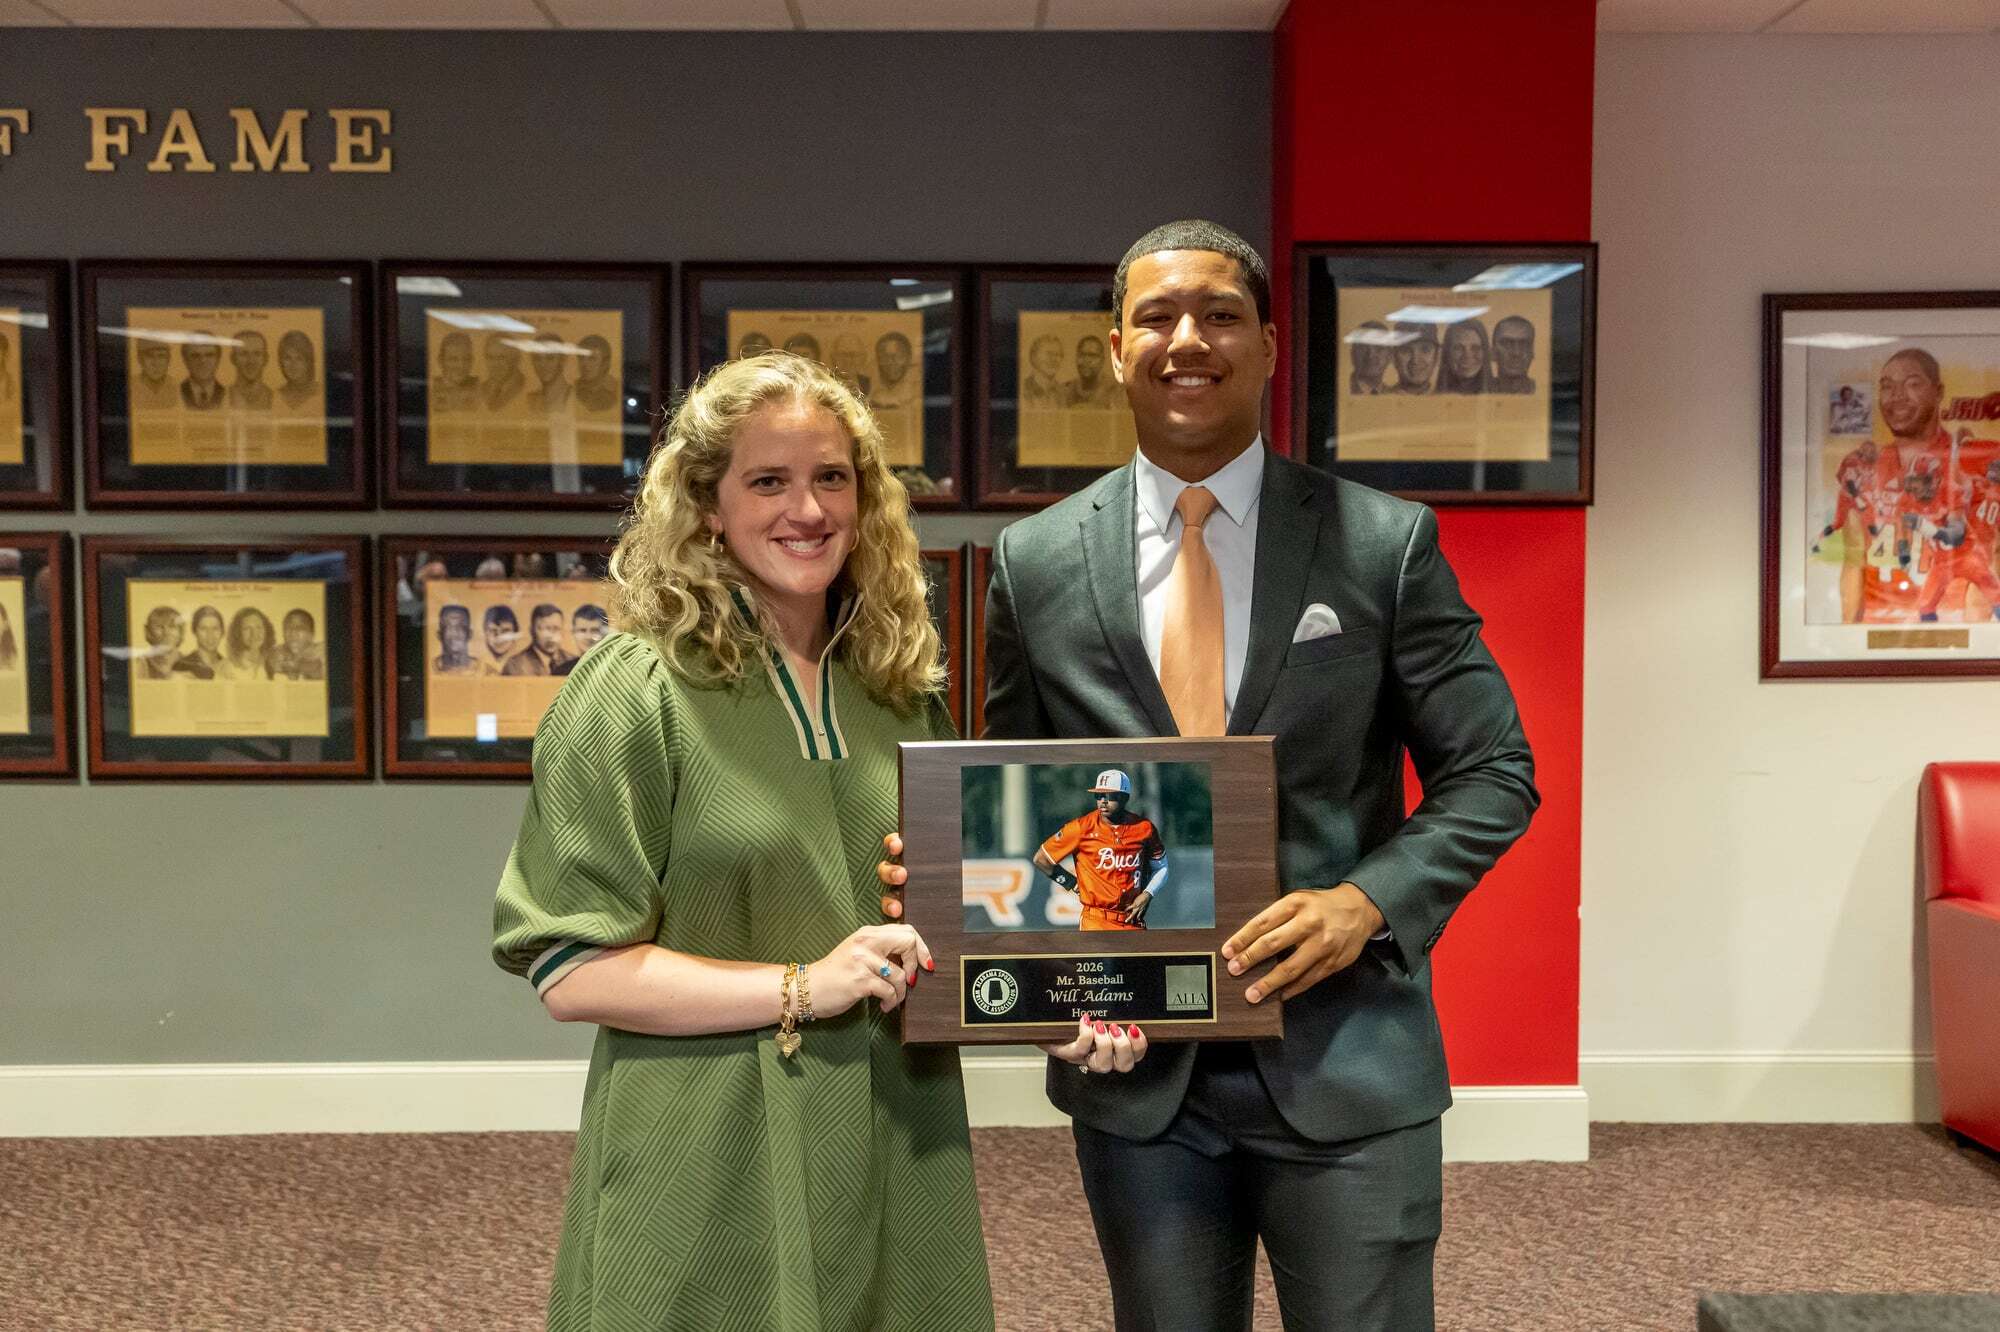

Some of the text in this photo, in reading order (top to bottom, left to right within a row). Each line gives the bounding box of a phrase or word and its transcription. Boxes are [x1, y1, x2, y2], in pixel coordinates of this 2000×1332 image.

[84, 108, 392, 173] FAME
[1096, 847, 1142, 869] Bucs
[1076, 962, 1104, 973] 2026
[1056, 974, 1124, 986] Mr. Baseball
[1045, 988, 1134, 1003] Will Adams
